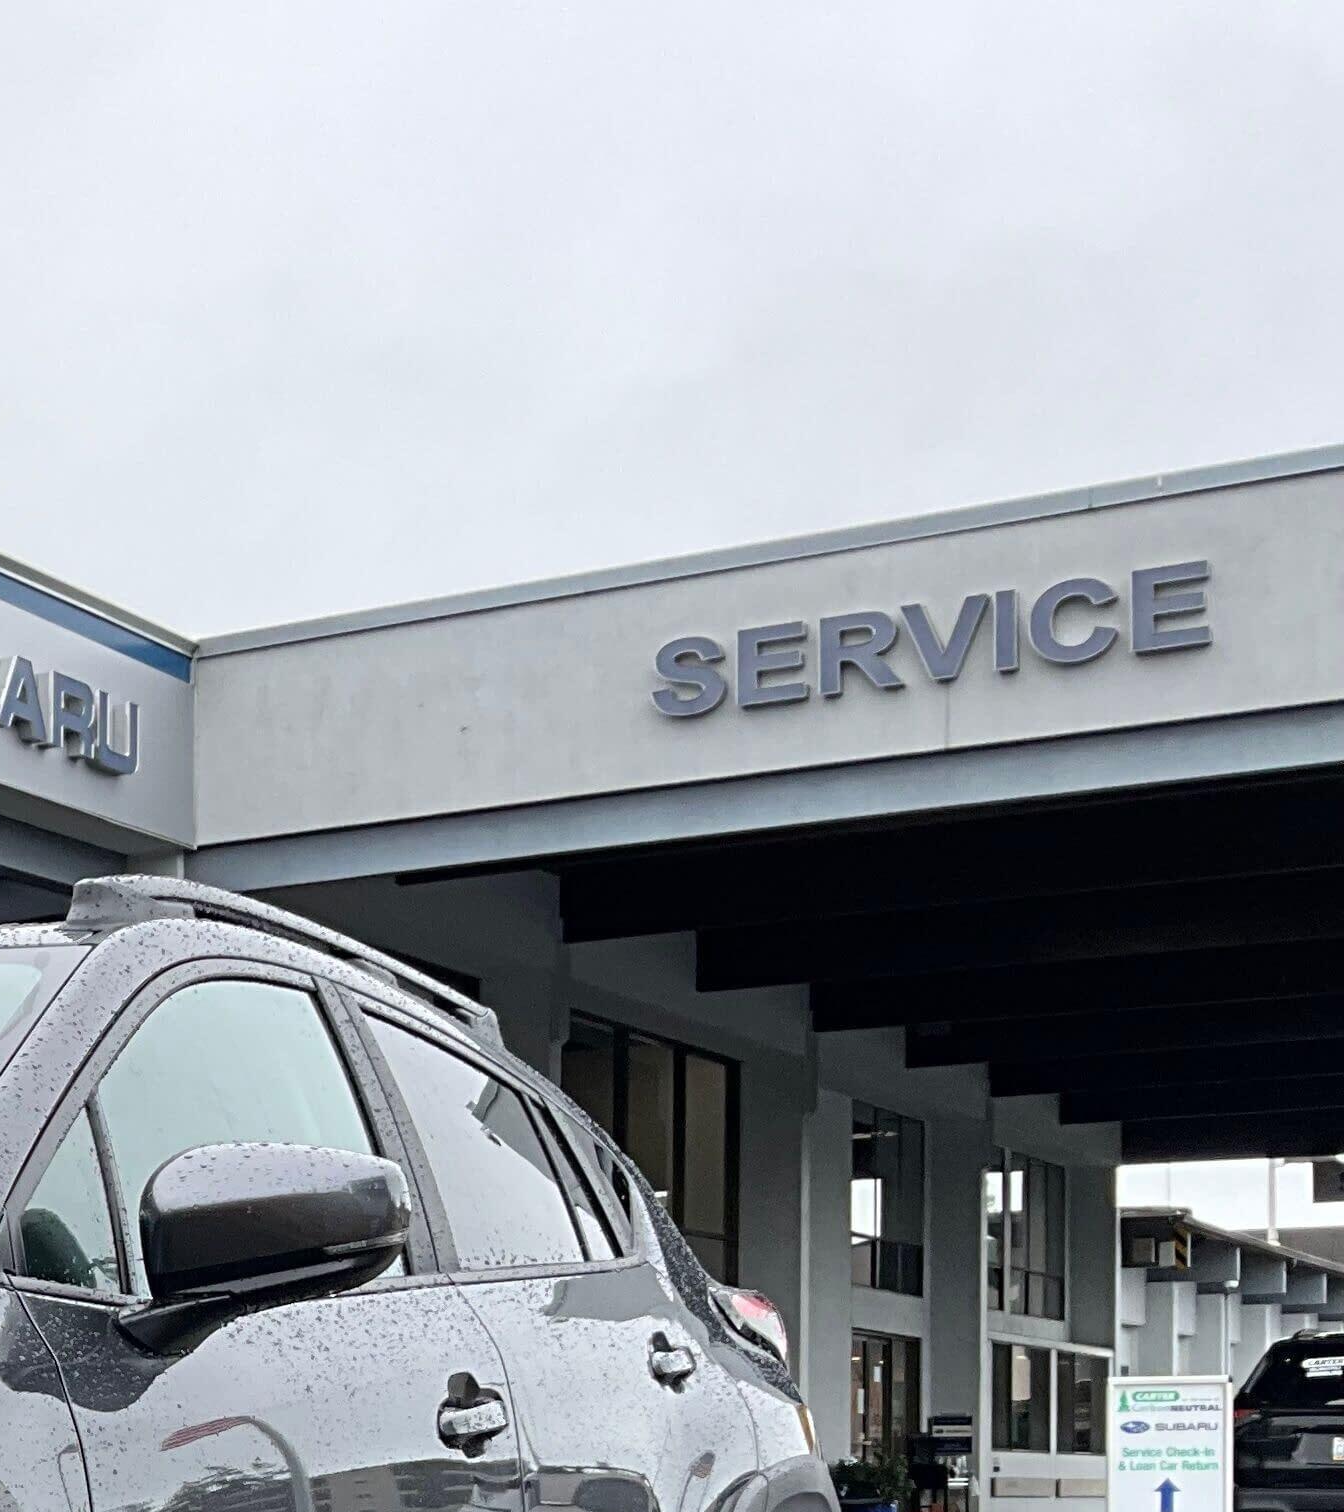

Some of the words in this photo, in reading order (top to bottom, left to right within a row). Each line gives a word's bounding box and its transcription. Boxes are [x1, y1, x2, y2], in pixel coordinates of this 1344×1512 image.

[652, 560, 1212, 718] SERVICE
[1155, 1423, 1218, 1431] SUBARU
[1122, 1447, 1161, 1457] Service
[1160, 1461, 1177, 1471] Car
